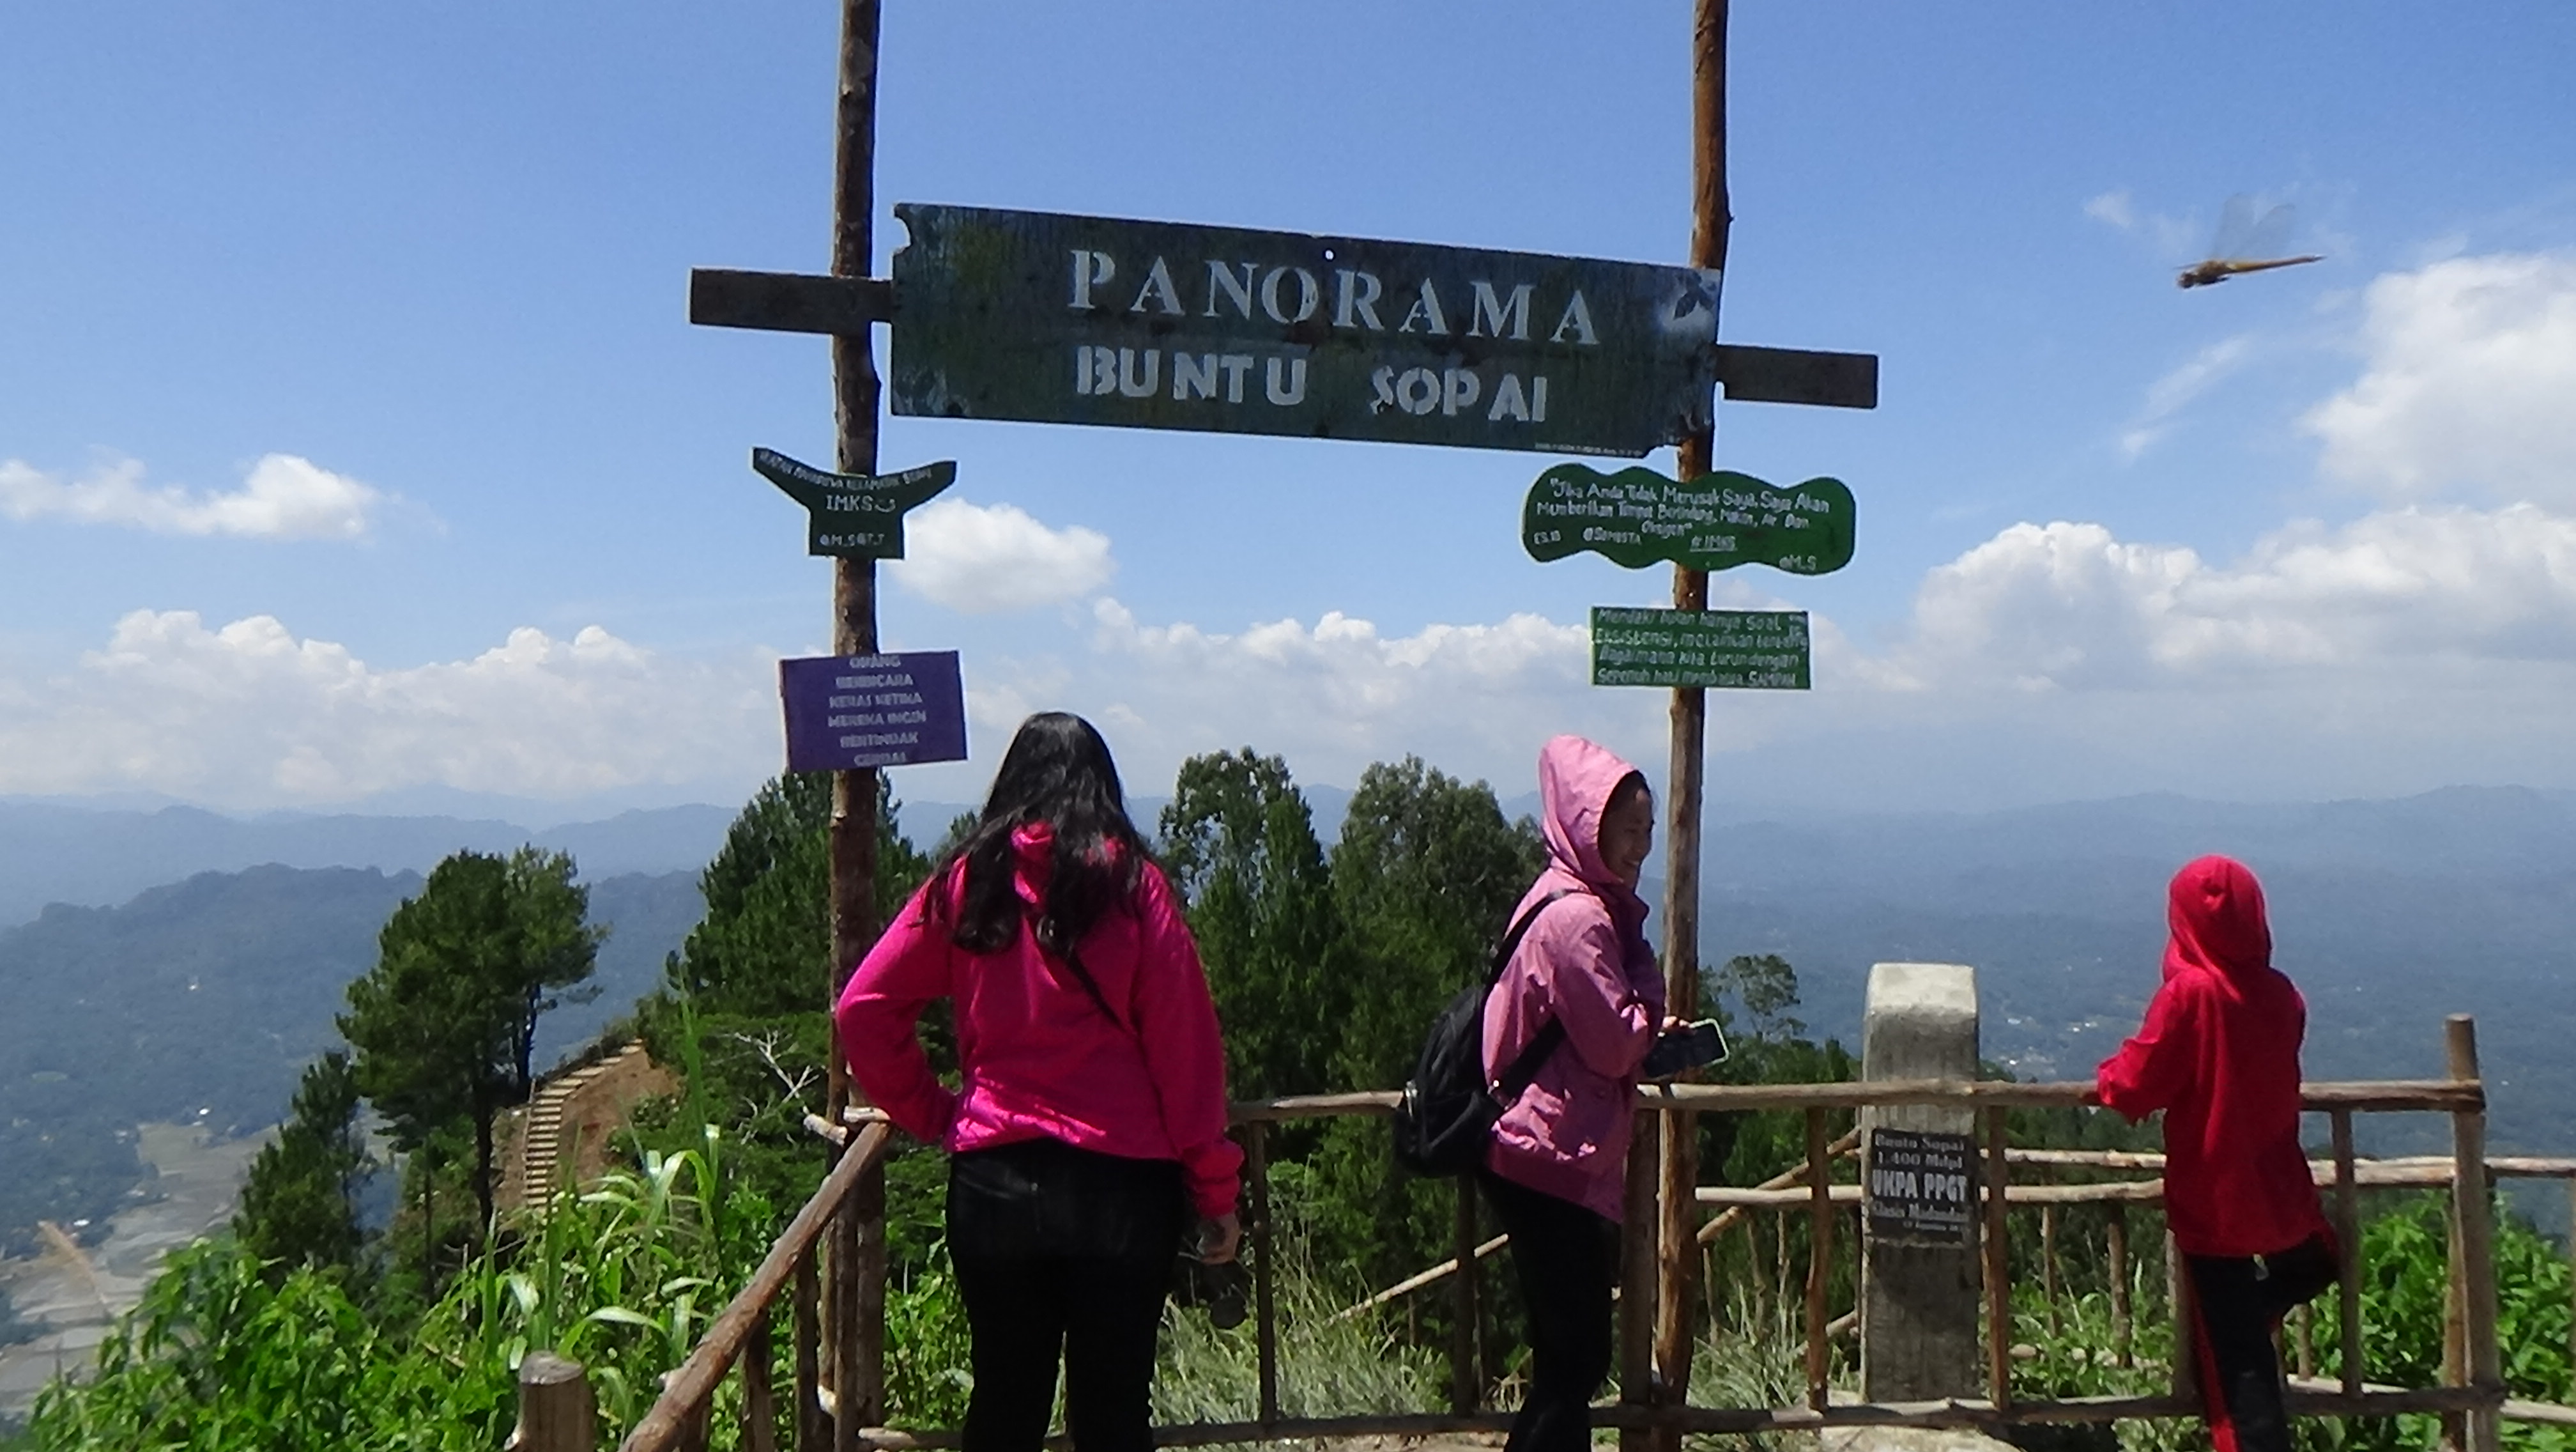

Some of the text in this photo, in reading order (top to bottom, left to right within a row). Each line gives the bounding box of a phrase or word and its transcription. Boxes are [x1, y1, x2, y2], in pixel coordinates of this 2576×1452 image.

[1067, 249, 1600, 345] PANORAMA
[1076, 345, 1547, 422] BUNTU SOPAI
[826, 495, 873, 511] IMKS
[1587, 483, 1623, 499] Anda
[1663, 484, 1719, 506] Merusak
[1795, 491, 1830, 513] Akan
